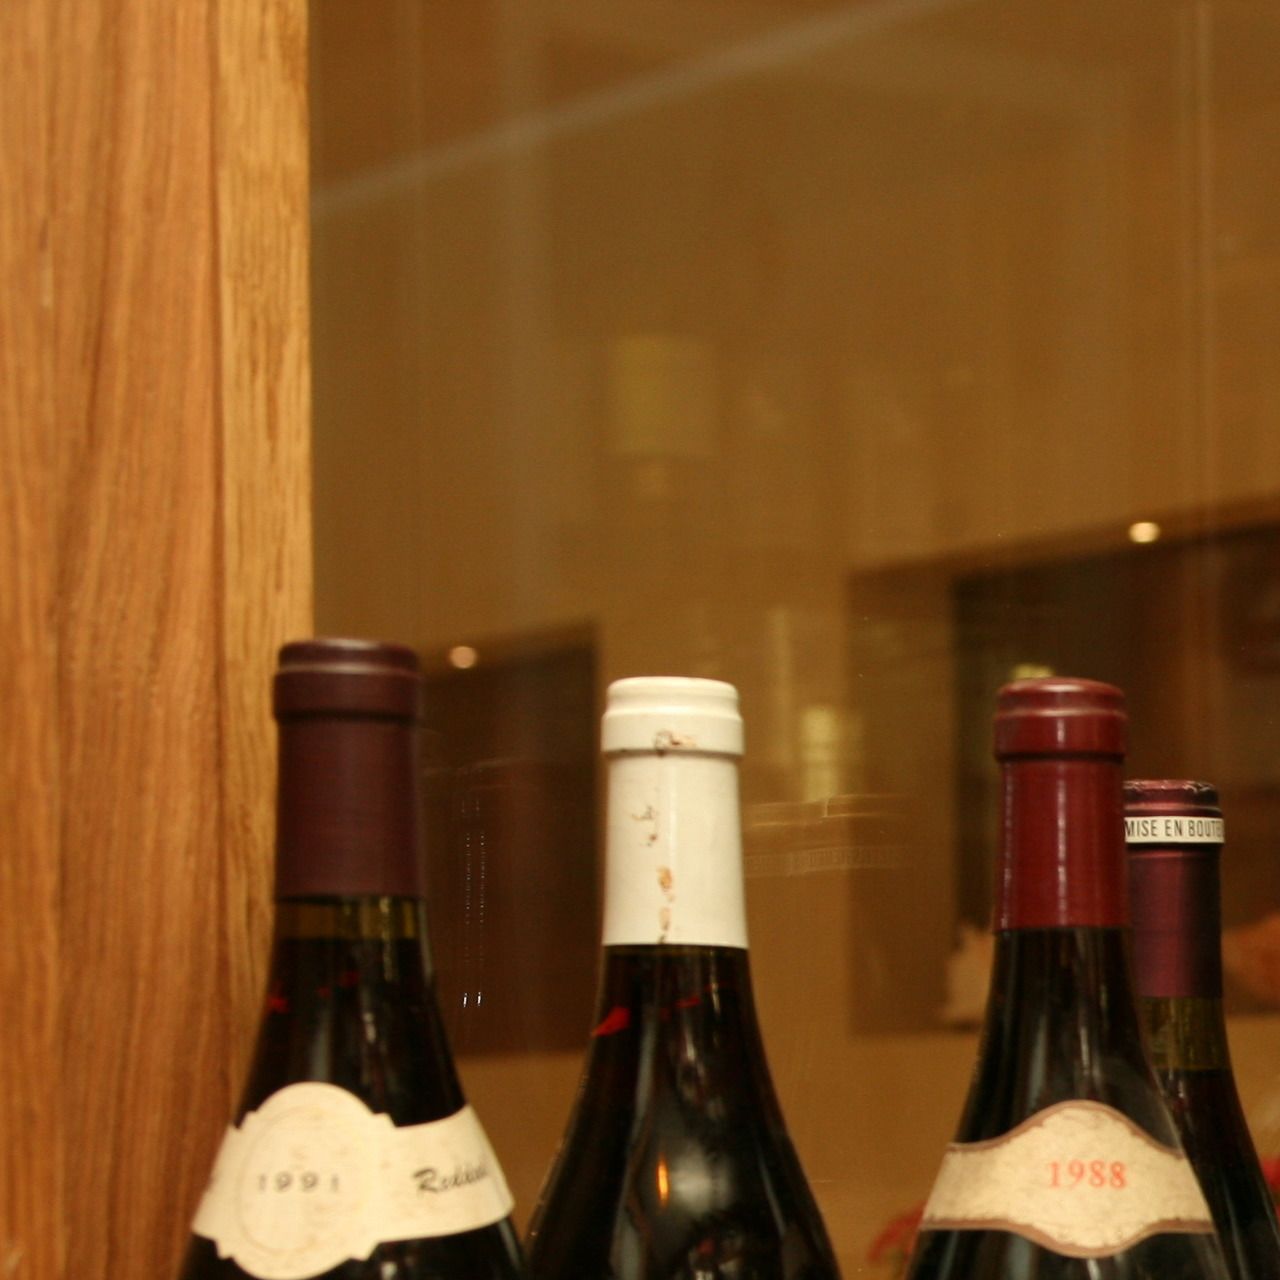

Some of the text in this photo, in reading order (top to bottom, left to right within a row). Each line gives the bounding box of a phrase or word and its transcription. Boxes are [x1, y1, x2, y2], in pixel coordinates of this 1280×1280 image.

[1125, 820, 1158, 837] MISE
[1165, 819, 1183, 837] EN
[257, 1171, 340, 1193] 1991
[1049, 1160, 1128, 1189] 1988
